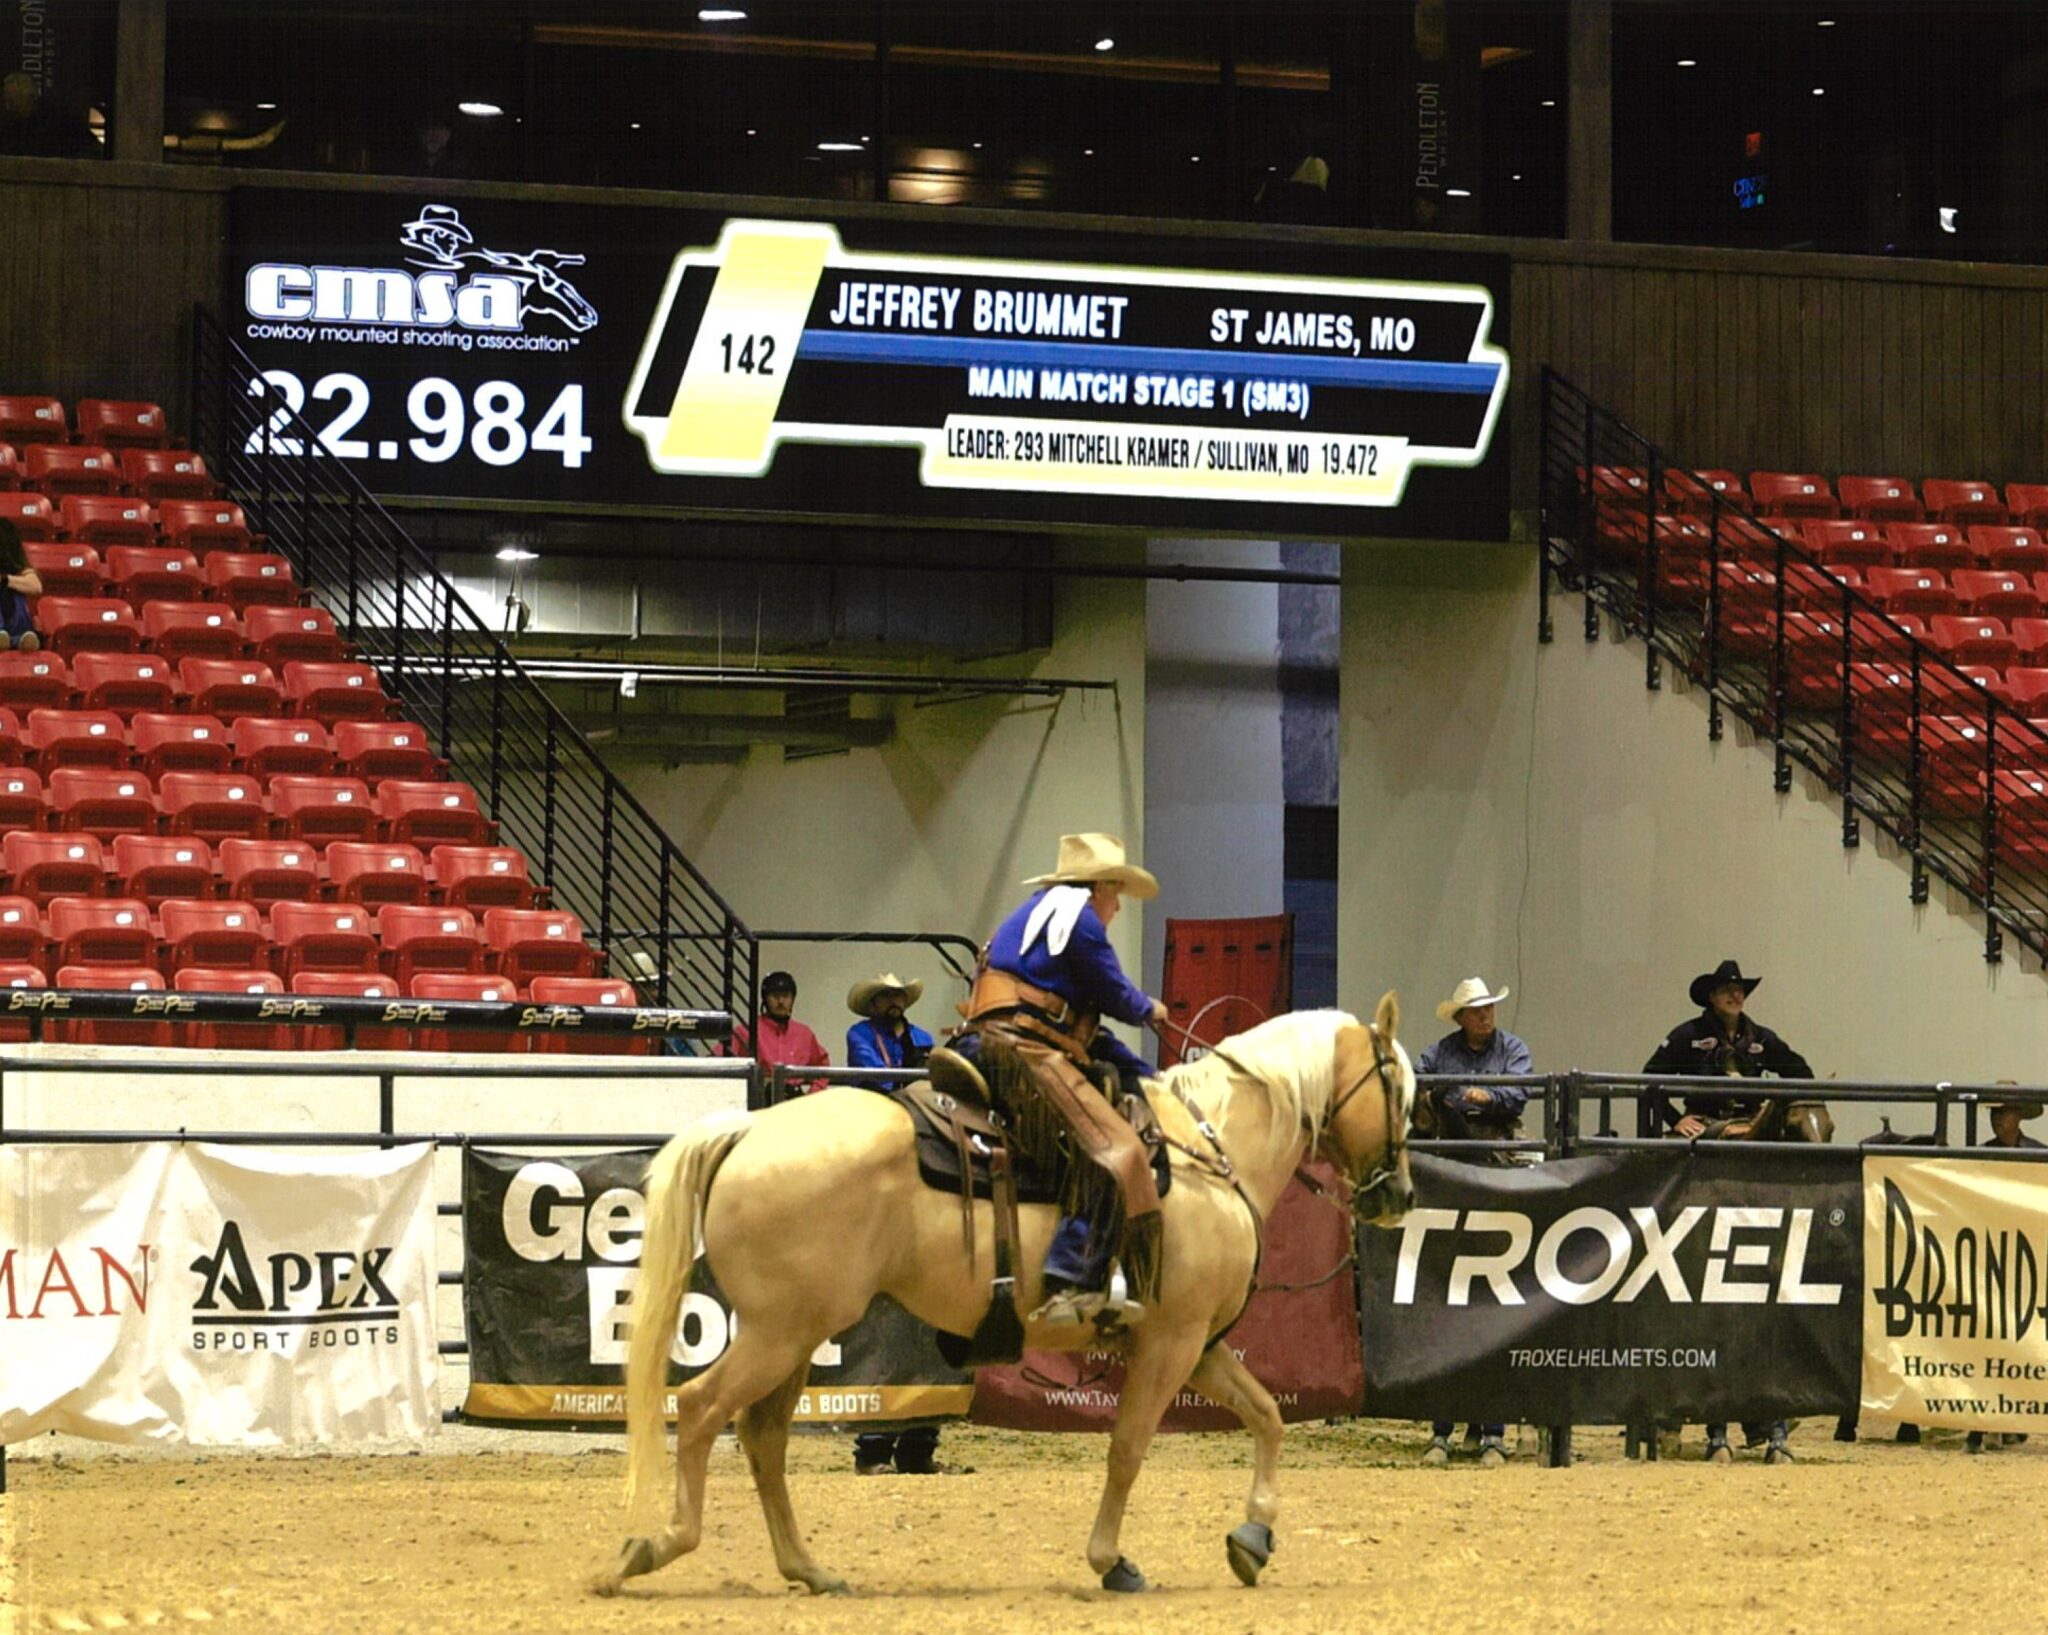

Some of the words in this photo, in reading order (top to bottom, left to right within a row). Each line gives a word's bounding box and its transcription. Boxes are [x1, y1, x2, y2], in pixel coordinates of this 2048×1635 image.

[1415, 82, 1439, 188] PENDLETON
[246, 263, 523, 331] cmsa
[830, 282, 961, 330] JEFFREY
[973, 289, 1128, 338] BRUMMET
[247, 322, 316, 342] cowboy
[320, 327, 398, 344] mounted
[402, 329, 473, 351] shooting
[721, 333, 776, 375] 142
[1210, 308, 1249, 343] ST
[1255, 310, 1361, 356] JAMES,
[1370, 316, 1415, 352] MO
[968, 366, 1033, 399] MAIN
[1040, 369, 1127, 404] MATCH
[1133, 374, 1215, 408] STAGE
[1222, 380, 1235, 409] 1
[1242, 381, 1310, 420] (SM3)
[244, 369, 592, 468] 22.984
[947, 428, 1010, 460] LEADER:
[1014, 431, 1044, 461] 293
[1048, 433, 1122, 466] MITCHELL
[1127, 436, 1189, 468] KRAMER
[1207, 440, 1282, 476] SULLIVAN,
[1287, 444, 1309, 474] MO
[1322, 443, 1377, 476] 19.472
[190, 1220, 400, 1311] APEX
[192, 1331, 290, 1350] SPORT
[309, 1326, 399, 1348] BOOTS
[1508, 1347, 1716, 1368] TROXELHELMETS.COM
[1903, 1356, 1974, 1378] Horse
[819, 1394, 881, 1414] BOOTS
